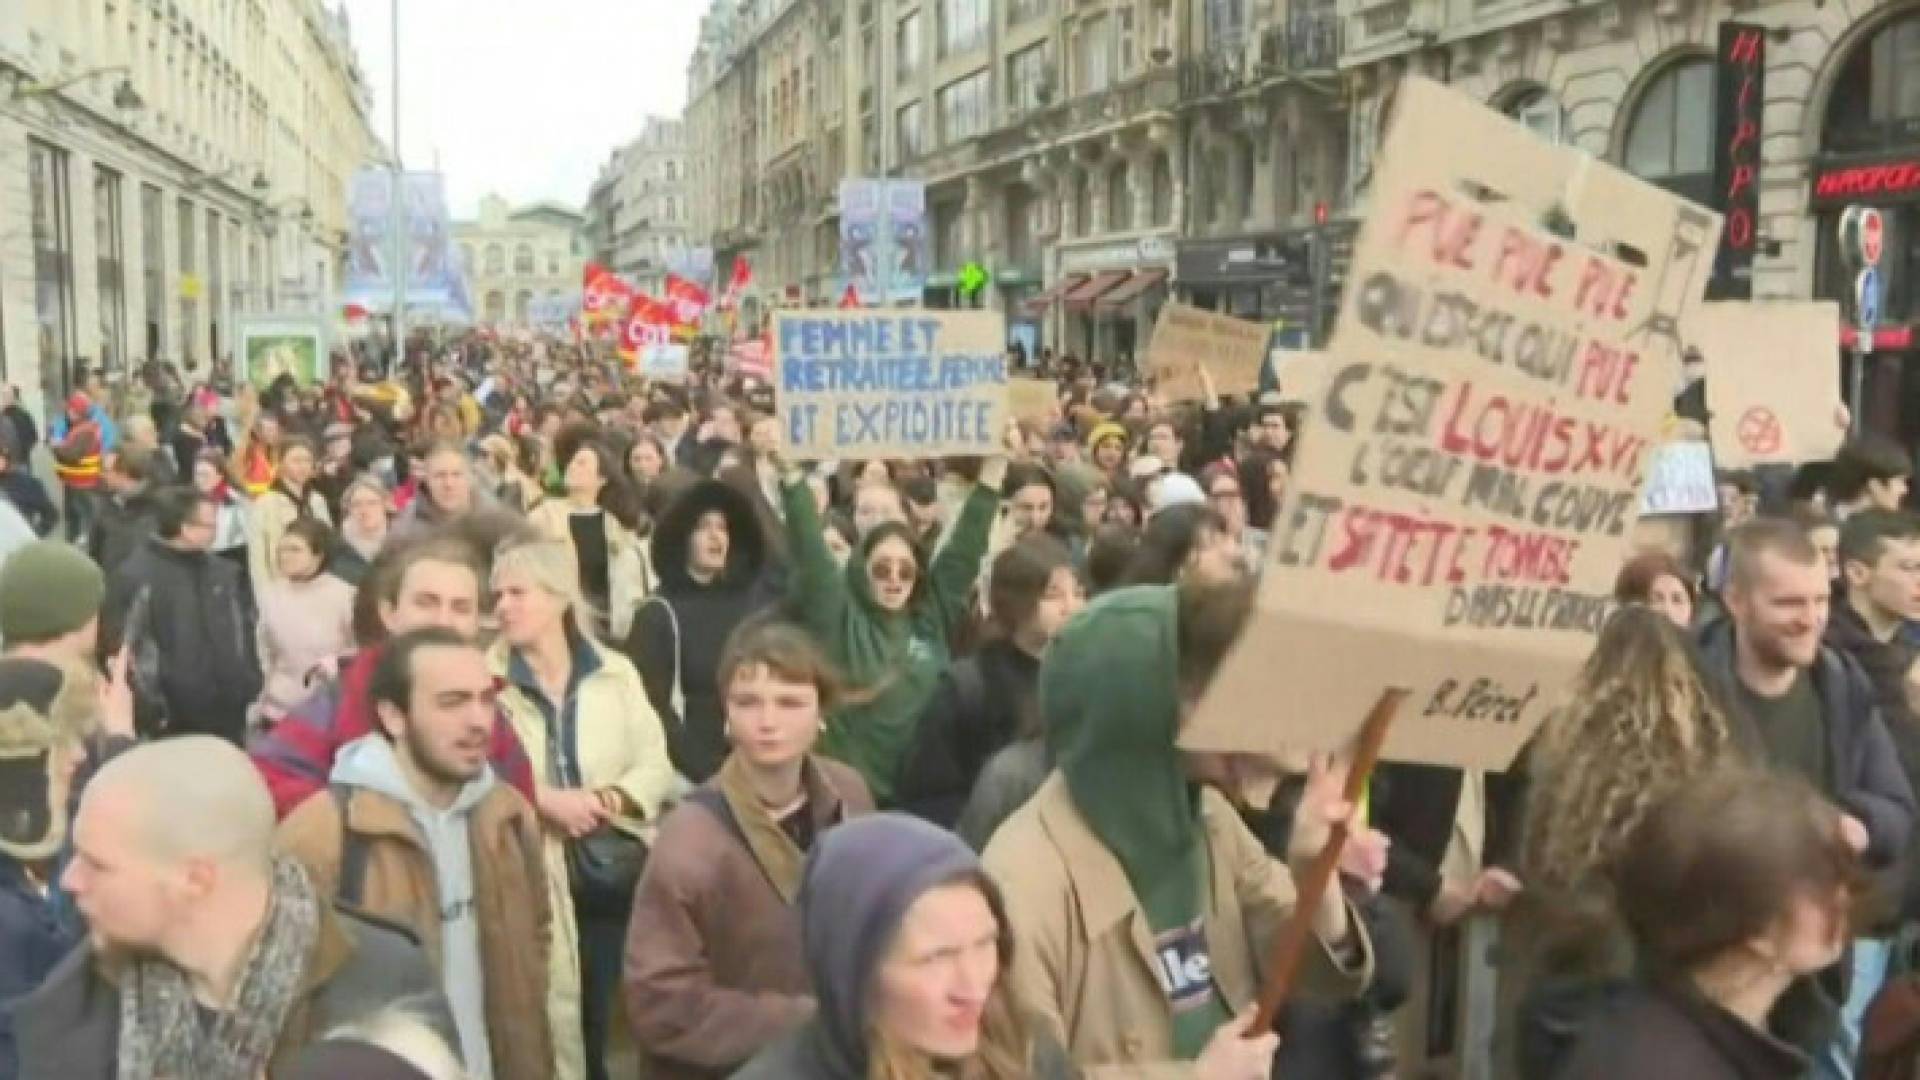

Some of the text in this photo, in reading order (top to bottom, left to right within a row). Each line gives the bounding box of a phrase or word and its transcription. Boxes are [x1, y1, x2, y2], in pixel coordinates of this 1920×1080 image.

[1729, 30, 1762, 247] HIPPO
[1400, 188, 1637, 321] PUE PUE PUE
[899, 317, 942, 356] ET
[1576, 339, 1640, 406] PUE
[788, 404, 819, 445] ET
[1439, 380, 1578, 473] LOUIS
[1279, 493, 1343, 567] ET
[1483, 523, 1582, 587] TOMBE
